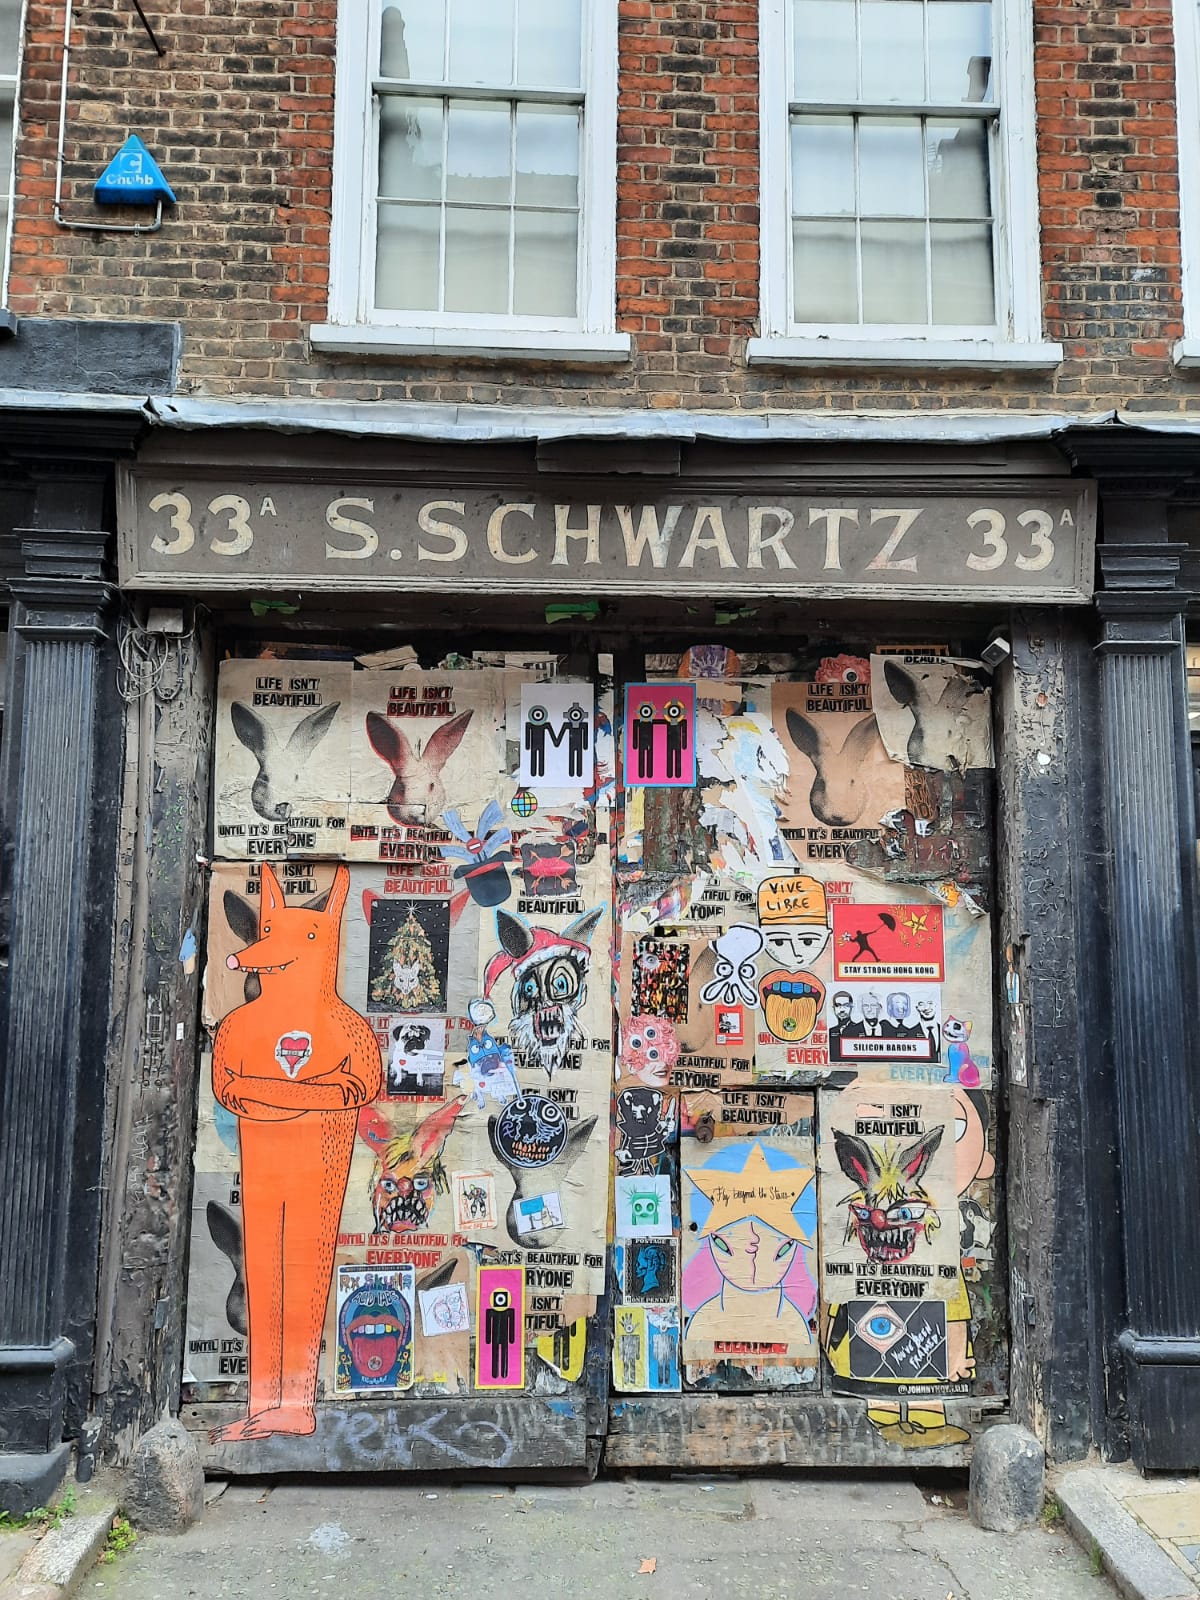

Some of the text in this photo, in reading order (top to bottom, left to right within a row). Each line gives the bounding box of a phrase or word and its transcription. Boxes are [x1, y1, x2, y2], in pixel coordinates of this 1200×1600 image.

[257, 678, 319, 690] LIFE ISN'T
[809, 684, 869, 695] LIFE ISN'T
[254, 693, 321, 706] BEAUTIFUL
[391, 687, 452, 699] LIFE ISN'T
[388, 703, 455, 716] BEAUTIFUL
[807, 700, 871, 712] BEAUTIFUL
[219, 826, 245, 837] UNTIL
[249, 822, 268, 835] IT'S
[327, 818, 346, 829] FOR
[808, 844, 849, 858] EVERY
[284, 865, 314, 877] ISN'T
[387, 864, 451, 877] LIFE ISN'T
[385, 880, 453, 893] BEAUTIFUL
[518, 901, 584, 913] BEAUTIFUL
[844, 966, 934, 975] STAY STRONG HONG KONG
[853, 1043, 917, 1052] SILICON BARONS
[787, 1049, 829, 1065] EVERY
[731, 1058, 750, 1071] FOR
[548, 1090, 577, 1102] ISN'T
[723, 1093, 786, 1107] LIFE ISN'T
[722, 1110, 787, 1124] BEAUTIFUL
[892, 1105, 922, 1117] ISN'T
[856, 1121, 924, 1135] BEAUTIFUL
[338, 1233, 365, 1245] UNTIL
[368, 1233, 390, 1246] IT'S
[394, 1234, 448, 1246] BEAUTIFUL
[527, 1252, 580, 1265] BEAUTIFUL
[584, 1253, 603, 1267] FOR
[826, 1263, 957, 1277] UNTIL IT'S BEAUTIFUL FOR
[532, 1296, 562, 1310] ISN'T
[190, 1338, 243, 1353] UNTIL IT'S
